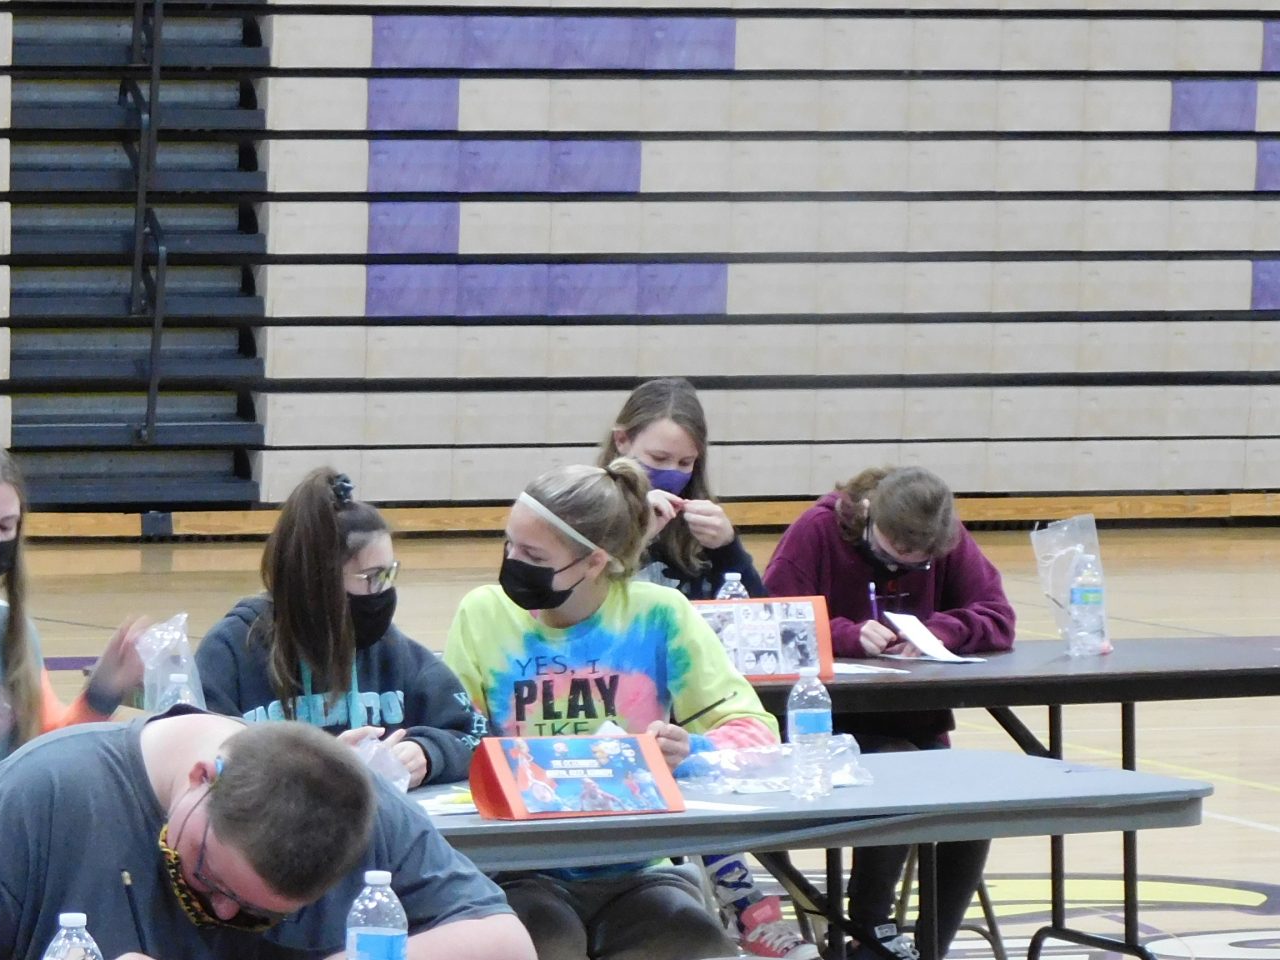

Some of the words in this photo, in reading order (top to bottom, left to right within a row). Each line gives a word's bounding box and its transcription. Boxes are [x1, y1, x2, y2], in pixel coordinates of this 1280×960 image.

[515, 655, 576, 677] YES,
[586, 658, 601, 675] I
[513, 675, 620, 722] PLAY
